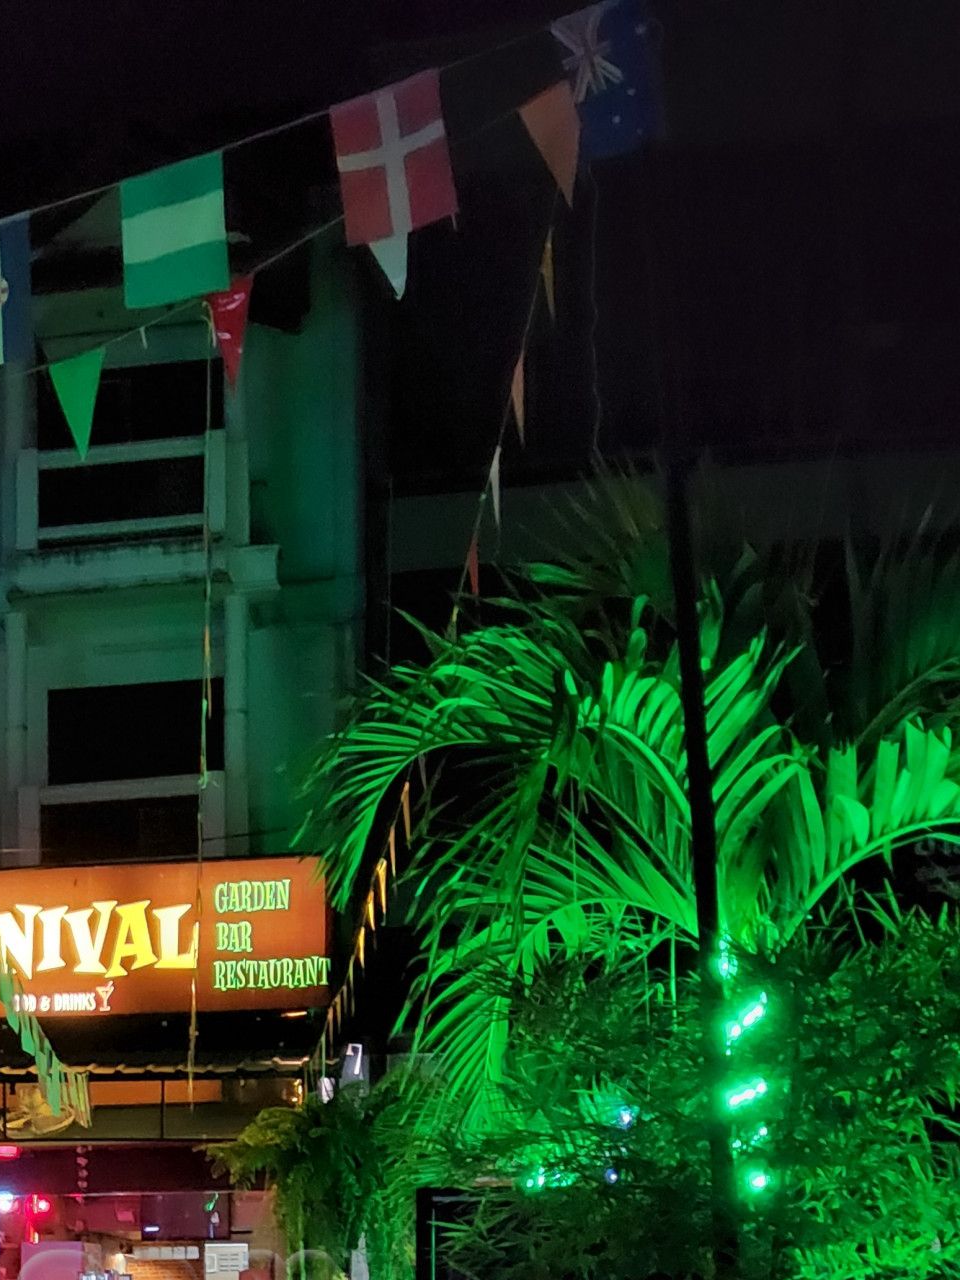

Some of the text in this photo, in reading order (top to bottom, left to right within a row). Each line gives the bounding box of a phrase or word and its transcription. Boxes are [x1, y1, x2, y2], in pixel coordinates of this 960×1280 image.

[215, 879, 291, 913] GARDEN
[216, 920, 253, 952] BAR
[213, 956, 331, 991] RESTAURANT
[40, 995, 50, 1012] &
[54, 992, 96, 1012] DRINKS
